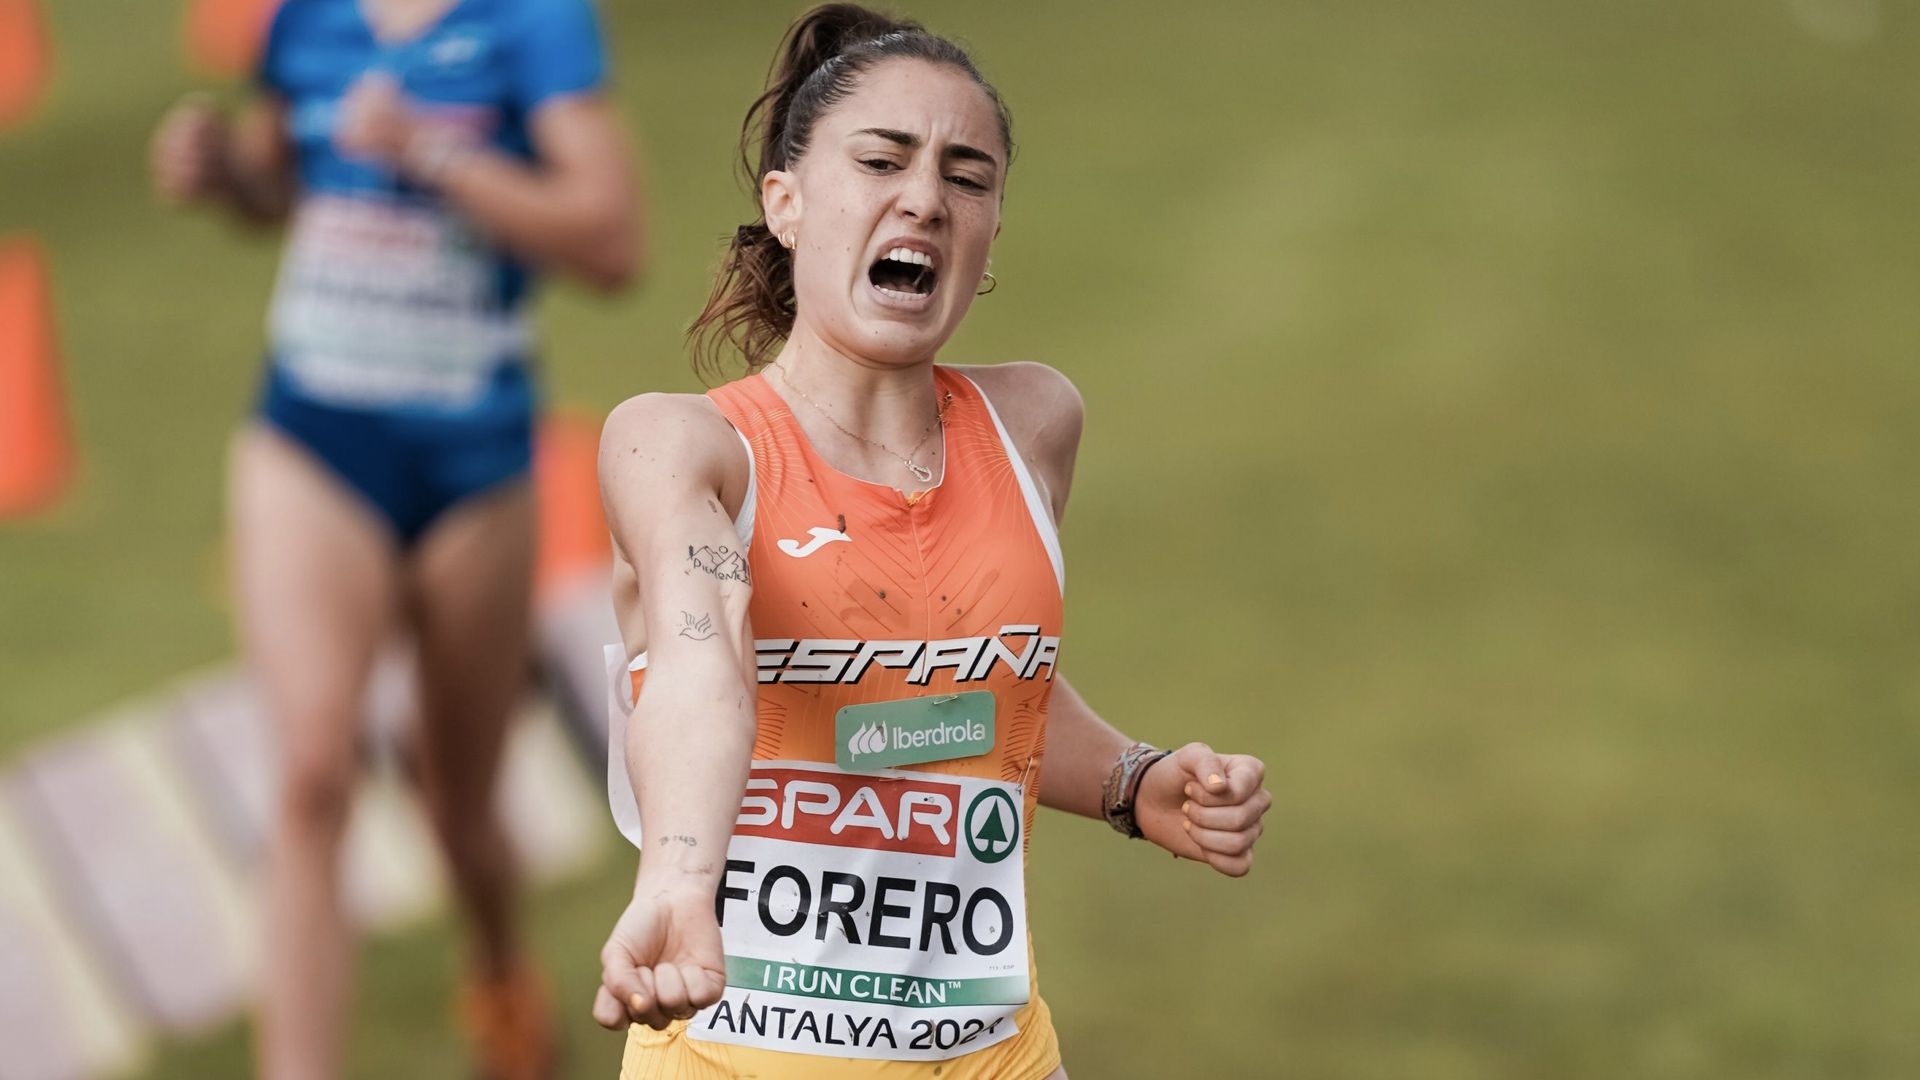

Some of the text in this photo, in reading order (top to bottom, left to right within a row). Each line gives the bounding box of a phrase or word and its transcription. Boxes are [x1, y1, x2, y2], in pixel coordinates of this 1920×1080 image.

[754, 624, 1061, 685] ESPAÑA
[892, 719, 986, 750] Iberdrola
[735, 778, 953, 846] SPAR
[715, 859, 1015, 956] FORERO
[762, 964, 771, 988] I
[776, 965, 843, 996] RUN
[707, 999, 899, 1049] ANTALYA
